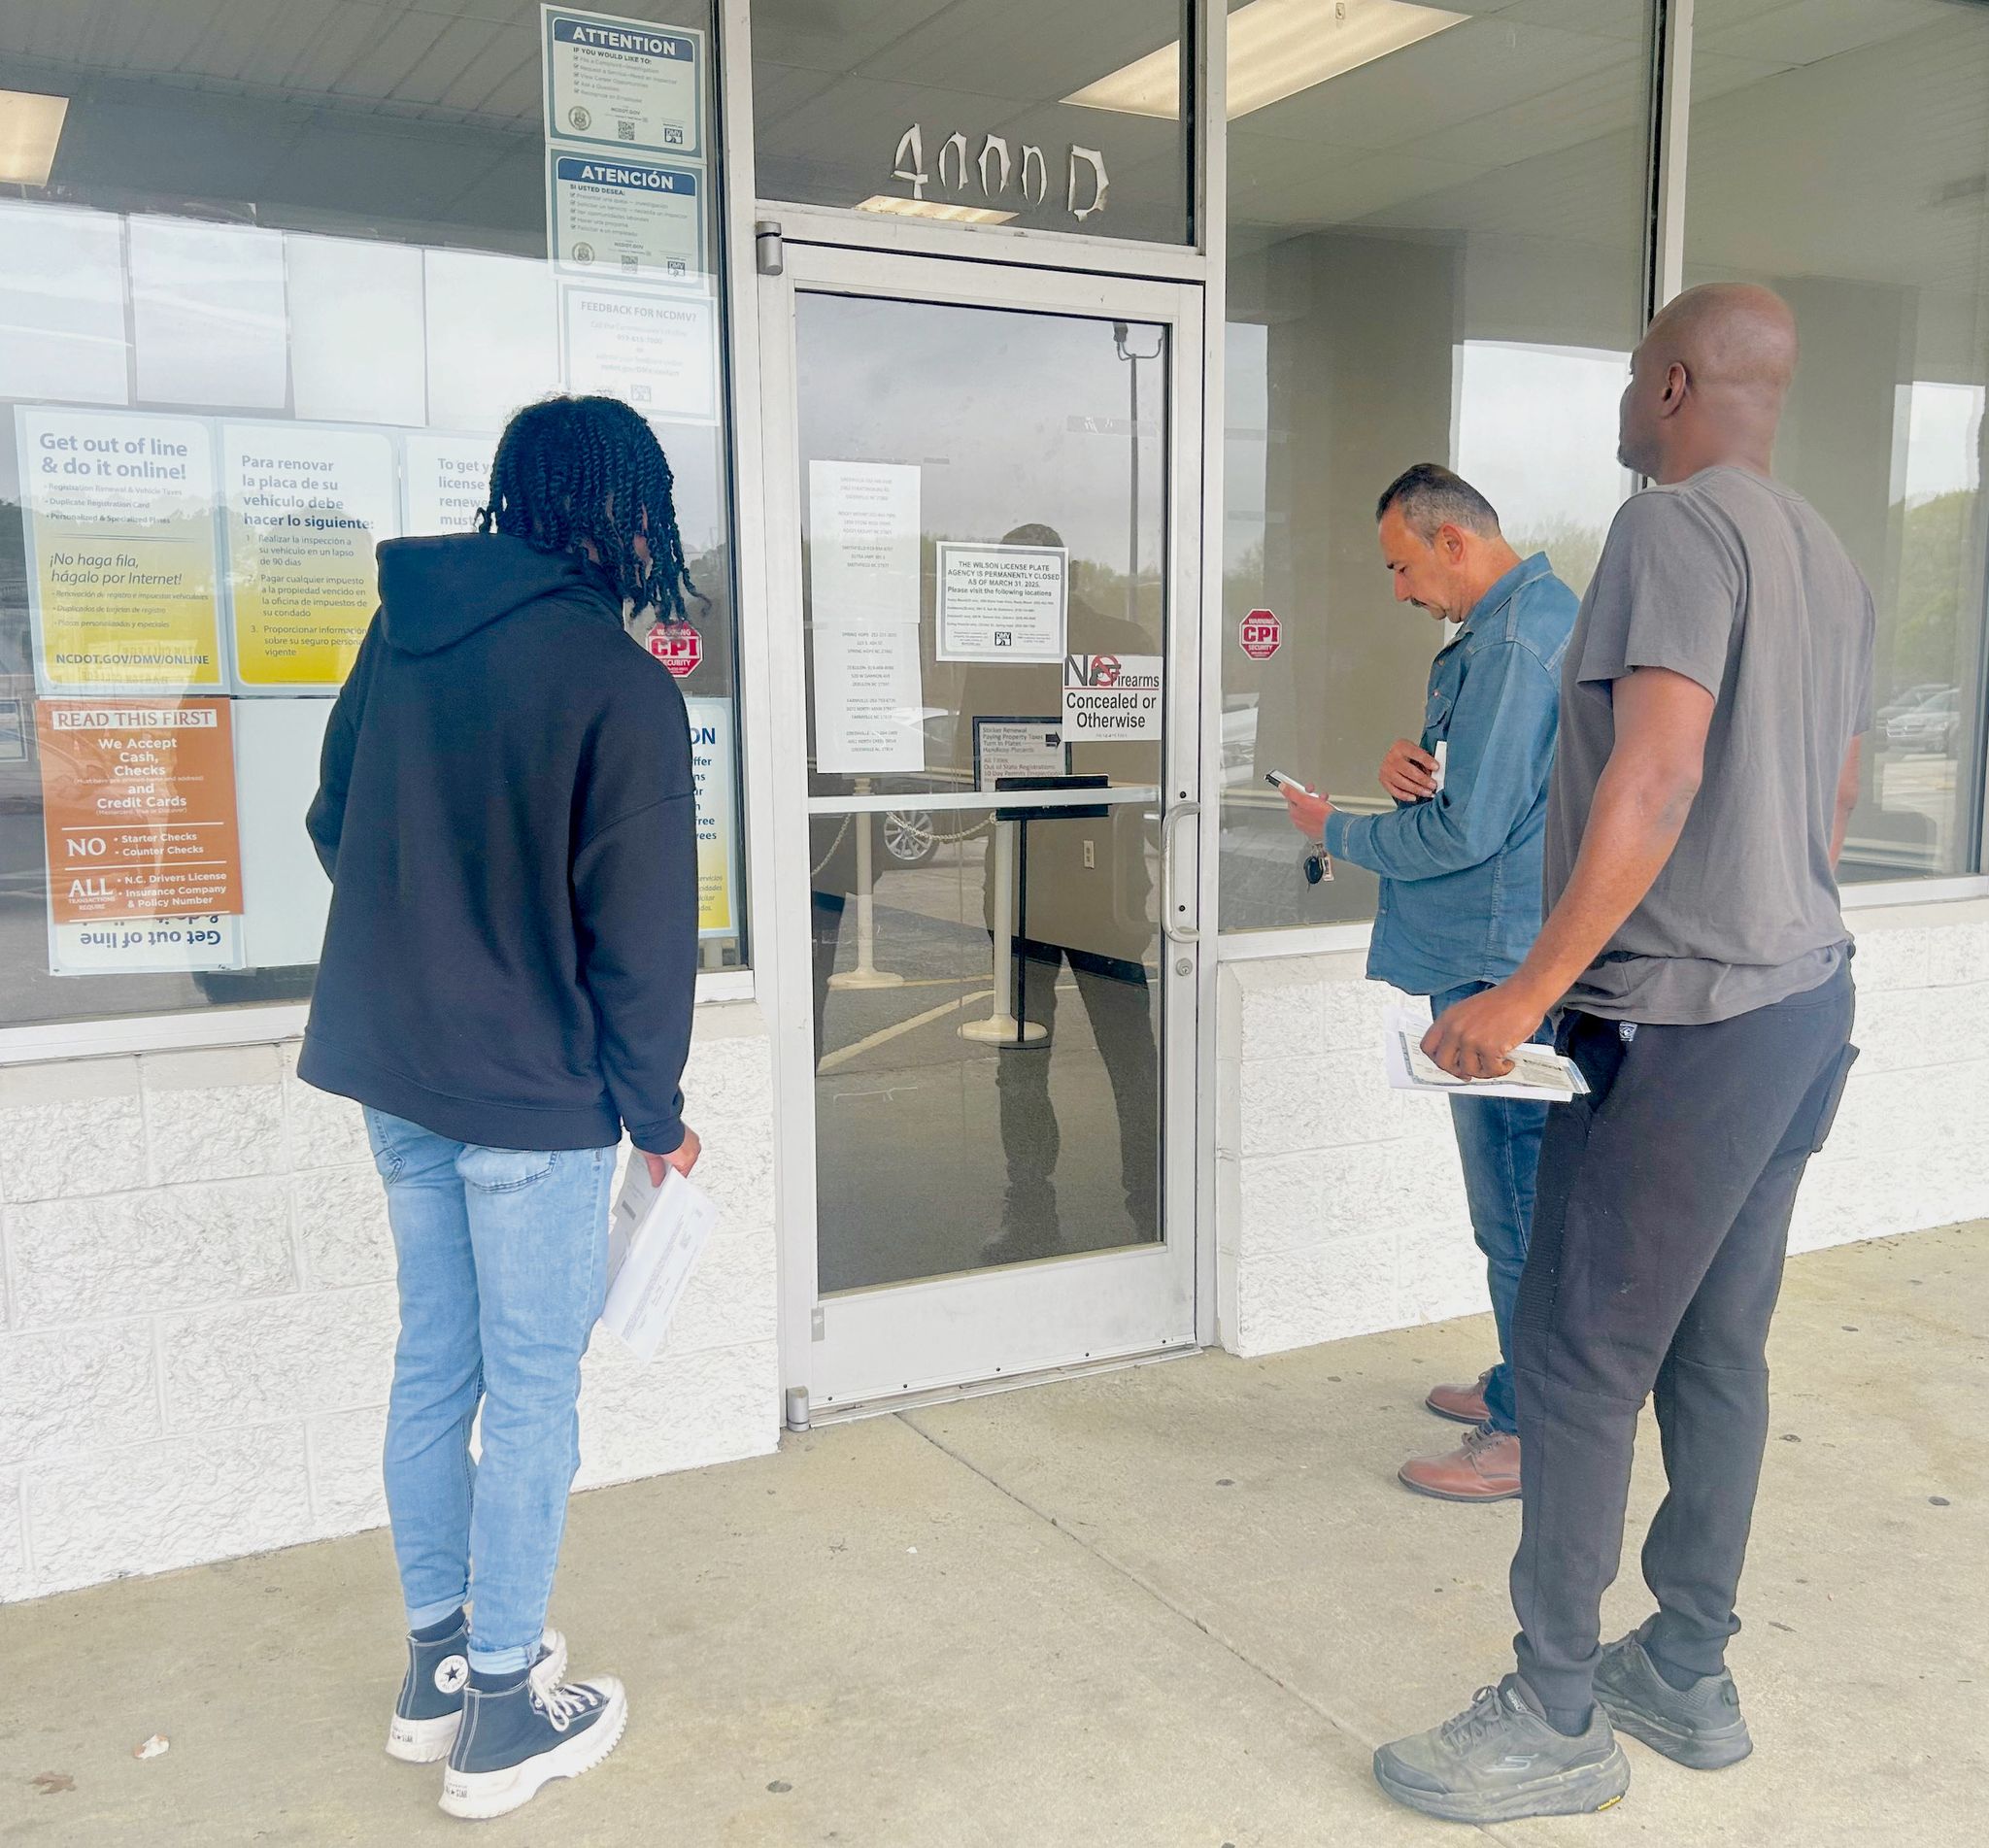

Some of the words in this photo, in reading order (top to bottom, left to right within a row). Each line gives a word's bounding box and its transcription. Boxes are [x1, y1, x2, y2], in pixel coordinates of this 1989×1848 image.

[573, 26, 676, 55] ATTENTION
[597, 50, 623, 60] WOULD
[624, 54, 639, 63] LIKE
[581, 165, 674, 189] ATENCIÓN
[581, 301, 631, 316] FEEDBACK
[634, 306, 655, 319] FOR
[656, 310, 697, 322] NCDMV?
[40, 433, 78, 451] Get
[84, 438, 119, 454] out
[124, 438, 145, 454] of
[151, 438, 187, 456] line
[42, 457, 58, 474] &
[63, 456, 91, 475] do
[97, 459, 112, 476] it
[117, 461, 186, 480] online!
[242, 454, 274, 468] Para
[278, 459, 334, 471] renovar
[438, 458, 453, 470] To
[457, 461, 479, 474] get
[242, 474, 255, 487] la
[258, 476, 297, 490] placa
[301, 477, 320, 489] de
[322, 481, 338, 490] su
[439, 476, 485, 489] license
[308, 496, 344, 510] debe
[244, 513, 284, 526] hacer
[287, 515, 301, 526] lo
[304, 516, 374, 530] siguiente:
[332, 549, 354, 557] lapso
[50, 553, 74, 568] ¡No
[77, 554, 112, 569] haga
[116, 554, 139, 568] fila,
[51, 569, 99, 586] hágalo
[102, 573, 125, 586] por
[128, 572, 183, 586] Internet!
[261, 574, 284, 585] Pagar
[287, 575, 323, 585] cualquier
[325, 576, 364, 585] impuesto
[278, 587, 320, 596] propiedad
[994, 588, 1024, 596] following
[313, 599, 355, 608] impuestos
[263, 624, 317, 635] Proporcionar
[1243, 626, 1278, 642] CPI
[300, 638, 329, 648] seguro
[652, 639, 697, 655] CPI
[55, 654, 210, 665] NCDOT.GOV/DMV/ONLINE
[264, 648, 296, 657] vigente
[1066, 692, 1137, 709] Concealed
[1142, 697, 1157, 709] or
[58, 713, 109, 726] READ
[115, 712, 157, 726] THIS
[163, 711, 212, 725] FIRST
[1076, 712, 1146, 728] Otherwise
[98, 739, 122, 749] We
[127, 738, 178, 751] Accept
[119, 752, 159, 764] Cash,
[114, 765, 166, 776] Checks
[128, 784, 154, 794] and
[97, 797, 141, 809] Credit
[147, 796, 186, 807] Cards
[121, 834, 157, 843] Starter
[161, 833, 197, 843] Checks
[66, 837, 106, 857] NO
[122, 847, 164, 857] Counter
[167, 846, 204, 855] Checks
[124, 875, 146, 885] N.C.
[150, 874, 185, 884] Drivers
[188, 872, 226, 881] License
[69, 878, 114, 897] ALL
[126, 888, 175, 897] Insurance
[178, 885, 226, 895] Company
[138, 898, 169, 908] Policy
[172, 896, 213, 906] Number
[81, 932, 117, 949] line
[121, 931, 143, 948] of
[148, 931, 181, 946] out
[186, 930, 221, 945] Get
